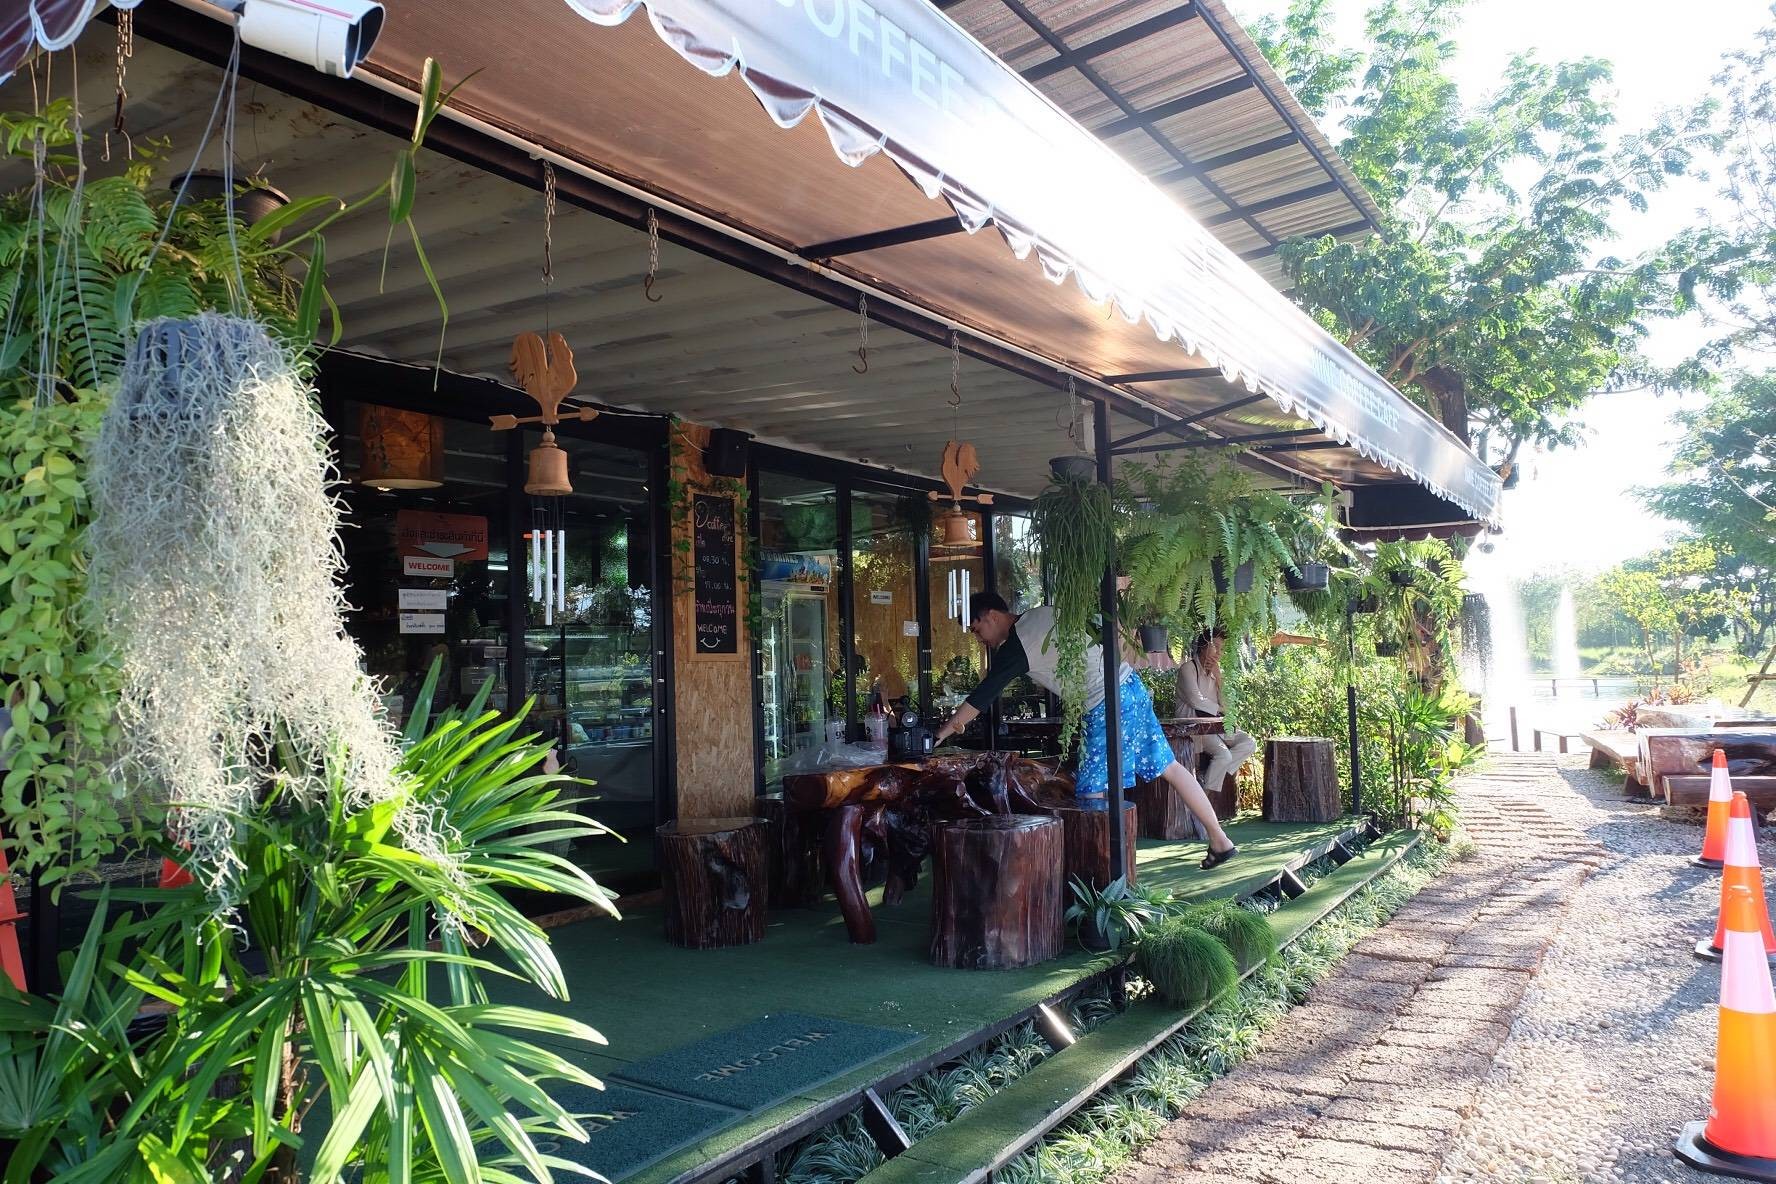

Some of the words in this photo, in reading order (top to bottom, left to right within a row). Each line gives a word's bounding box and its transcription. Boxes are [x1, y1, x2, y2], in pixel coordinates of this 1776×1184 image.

[773, 0, 967, 124] OFFEE
[408, 562, 451, 572] WELCOME
[697, 623, 727, 635] WELCOME
[694, 1032, 833, 1083] WELCOME
